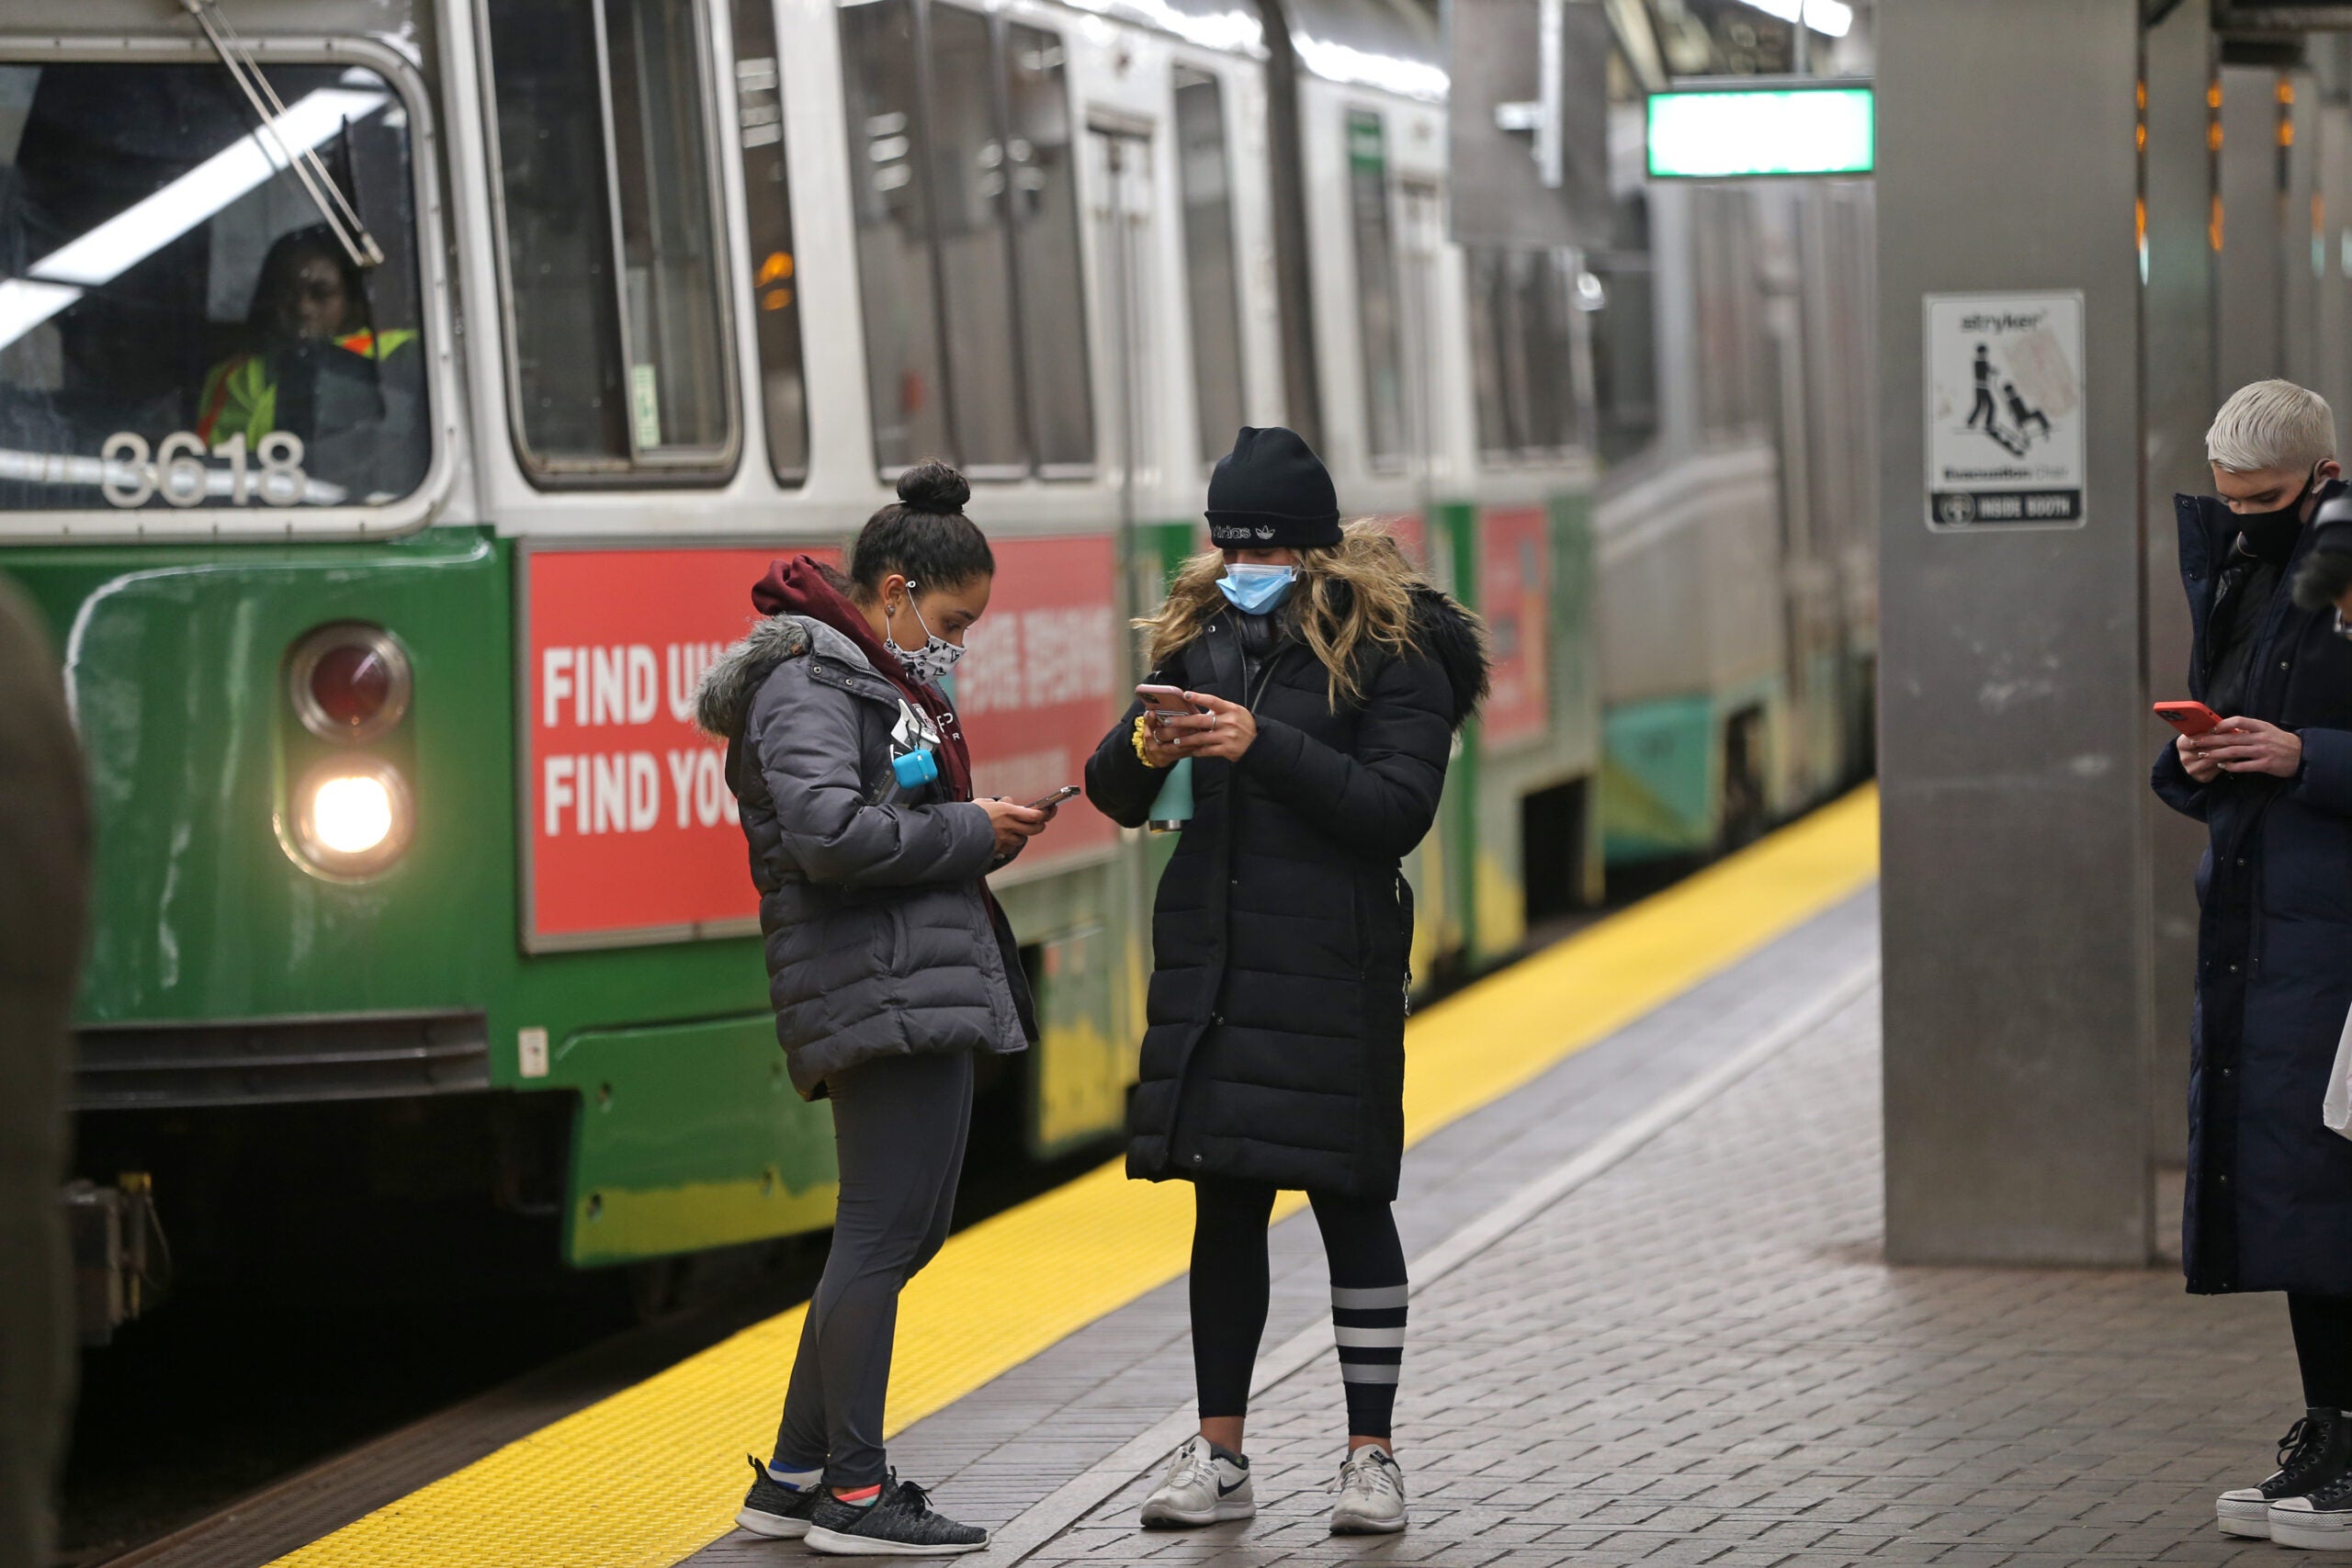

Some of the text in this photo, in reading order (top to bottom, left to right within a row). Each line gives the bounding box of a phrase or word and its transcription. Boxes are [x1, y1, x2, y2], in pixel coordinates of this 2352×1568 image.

[1961, 312, 2041, 333] stryker
[1979, 495, 2070, 518] INSIDE BOOTH
[544, 645, 658, 728] FIND
[545, 751, 660, 837] FIND
